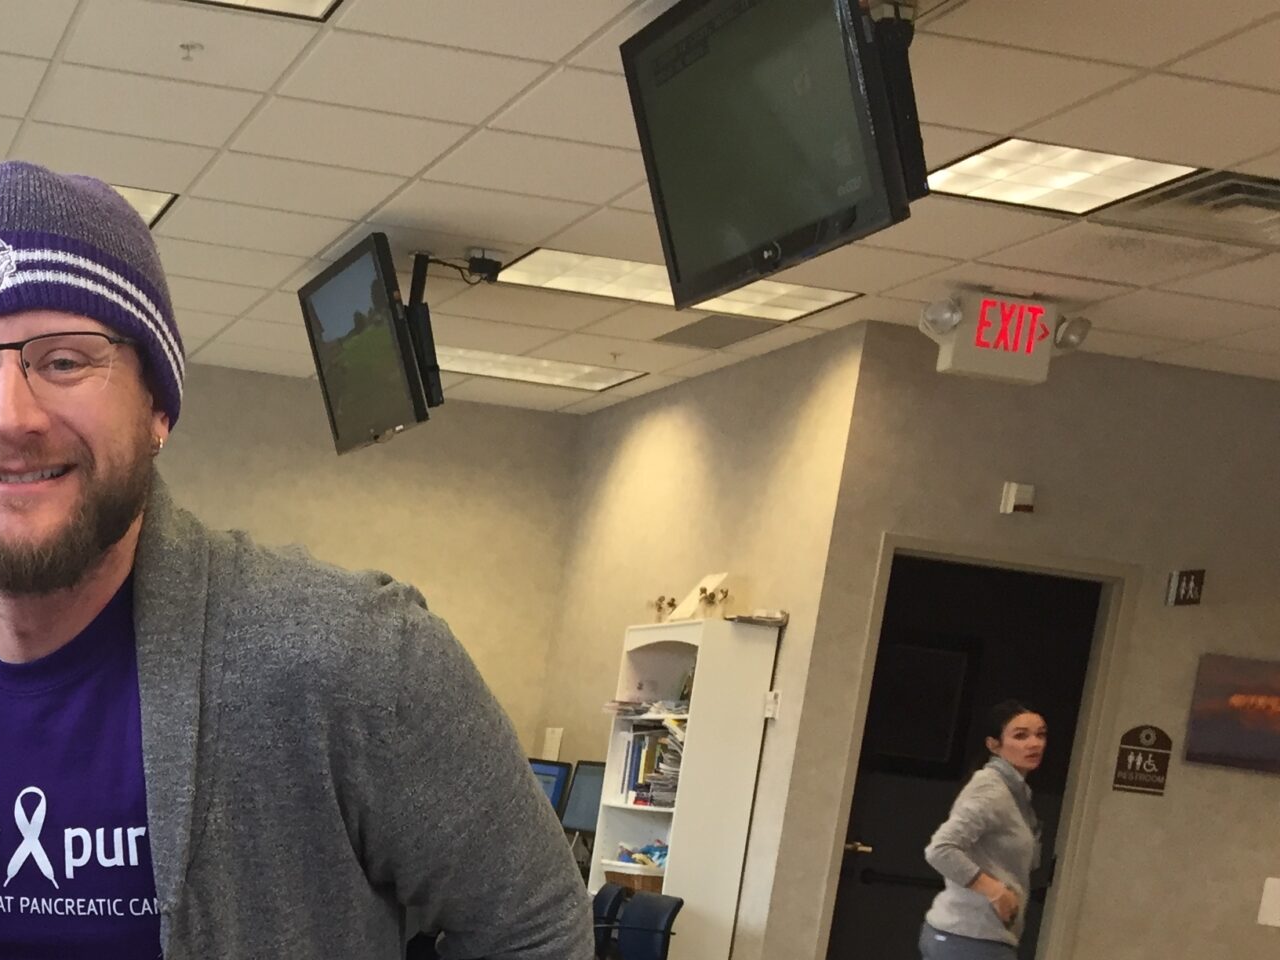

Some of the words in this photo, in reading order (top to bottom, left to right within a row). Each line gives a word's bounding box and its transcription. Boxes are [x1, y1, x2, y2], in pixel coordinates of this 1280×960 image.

[975, 298, 1045, 356] EXIT
[64, 826, 146, 879] pur
[19, 896, 125, 916] PANCREATIC
